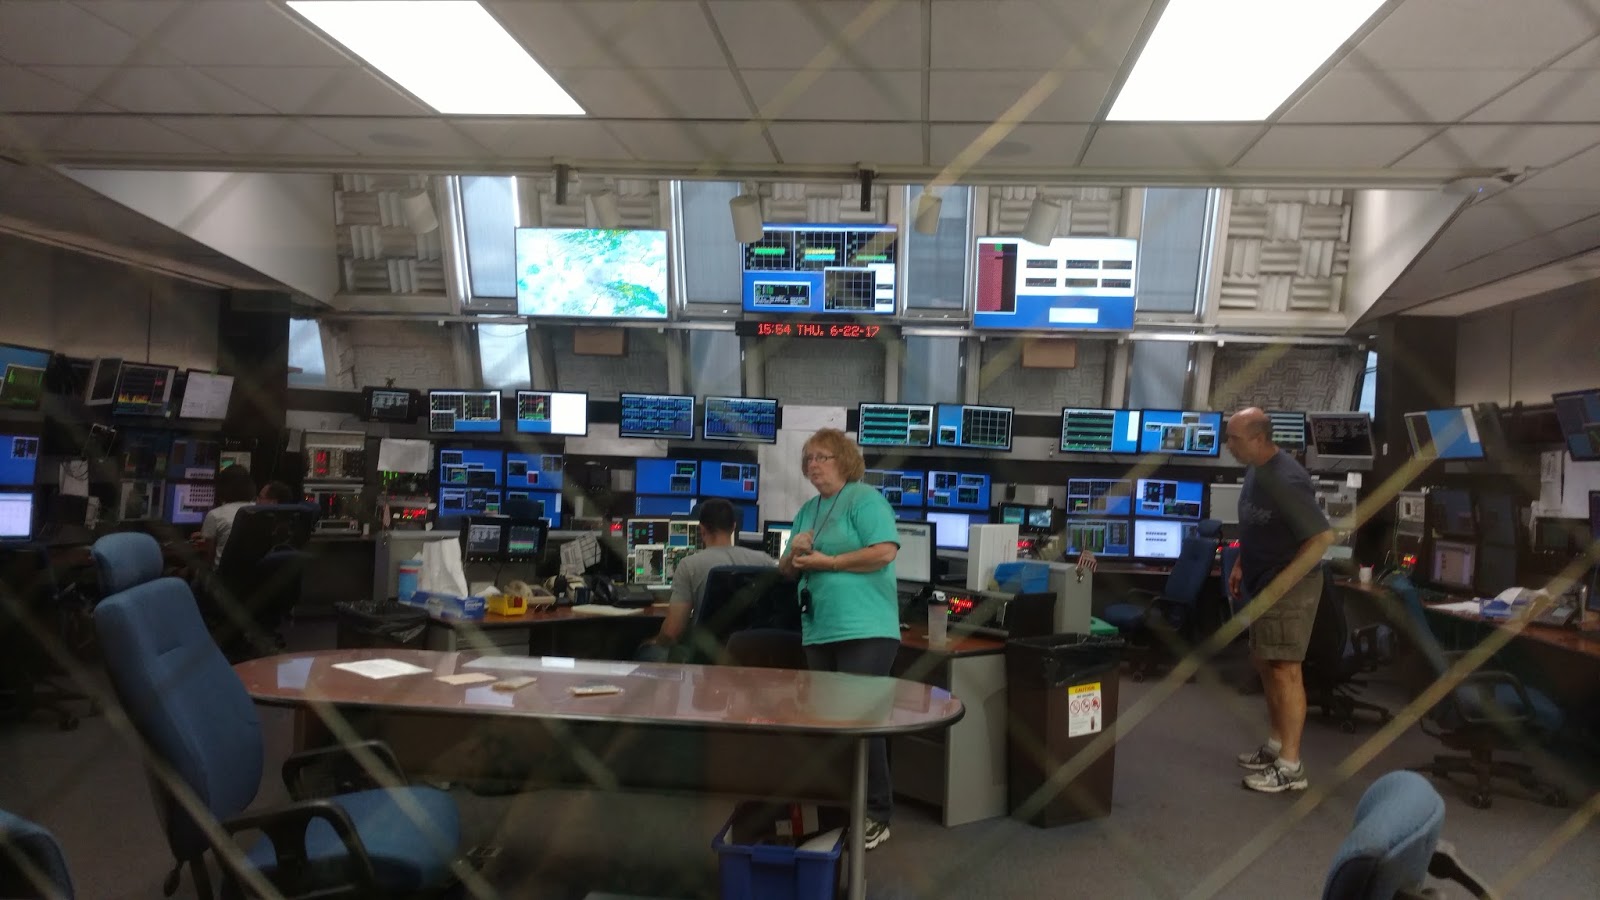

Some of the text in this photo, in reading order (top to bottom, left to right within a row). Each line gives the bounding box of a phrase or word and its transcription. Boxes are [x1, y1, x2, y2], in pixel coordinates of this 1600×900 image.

[758, 323, 880, 337] 15:54 THU. 6-22-17
[1075, 685, 1095, 693] CAUTION
